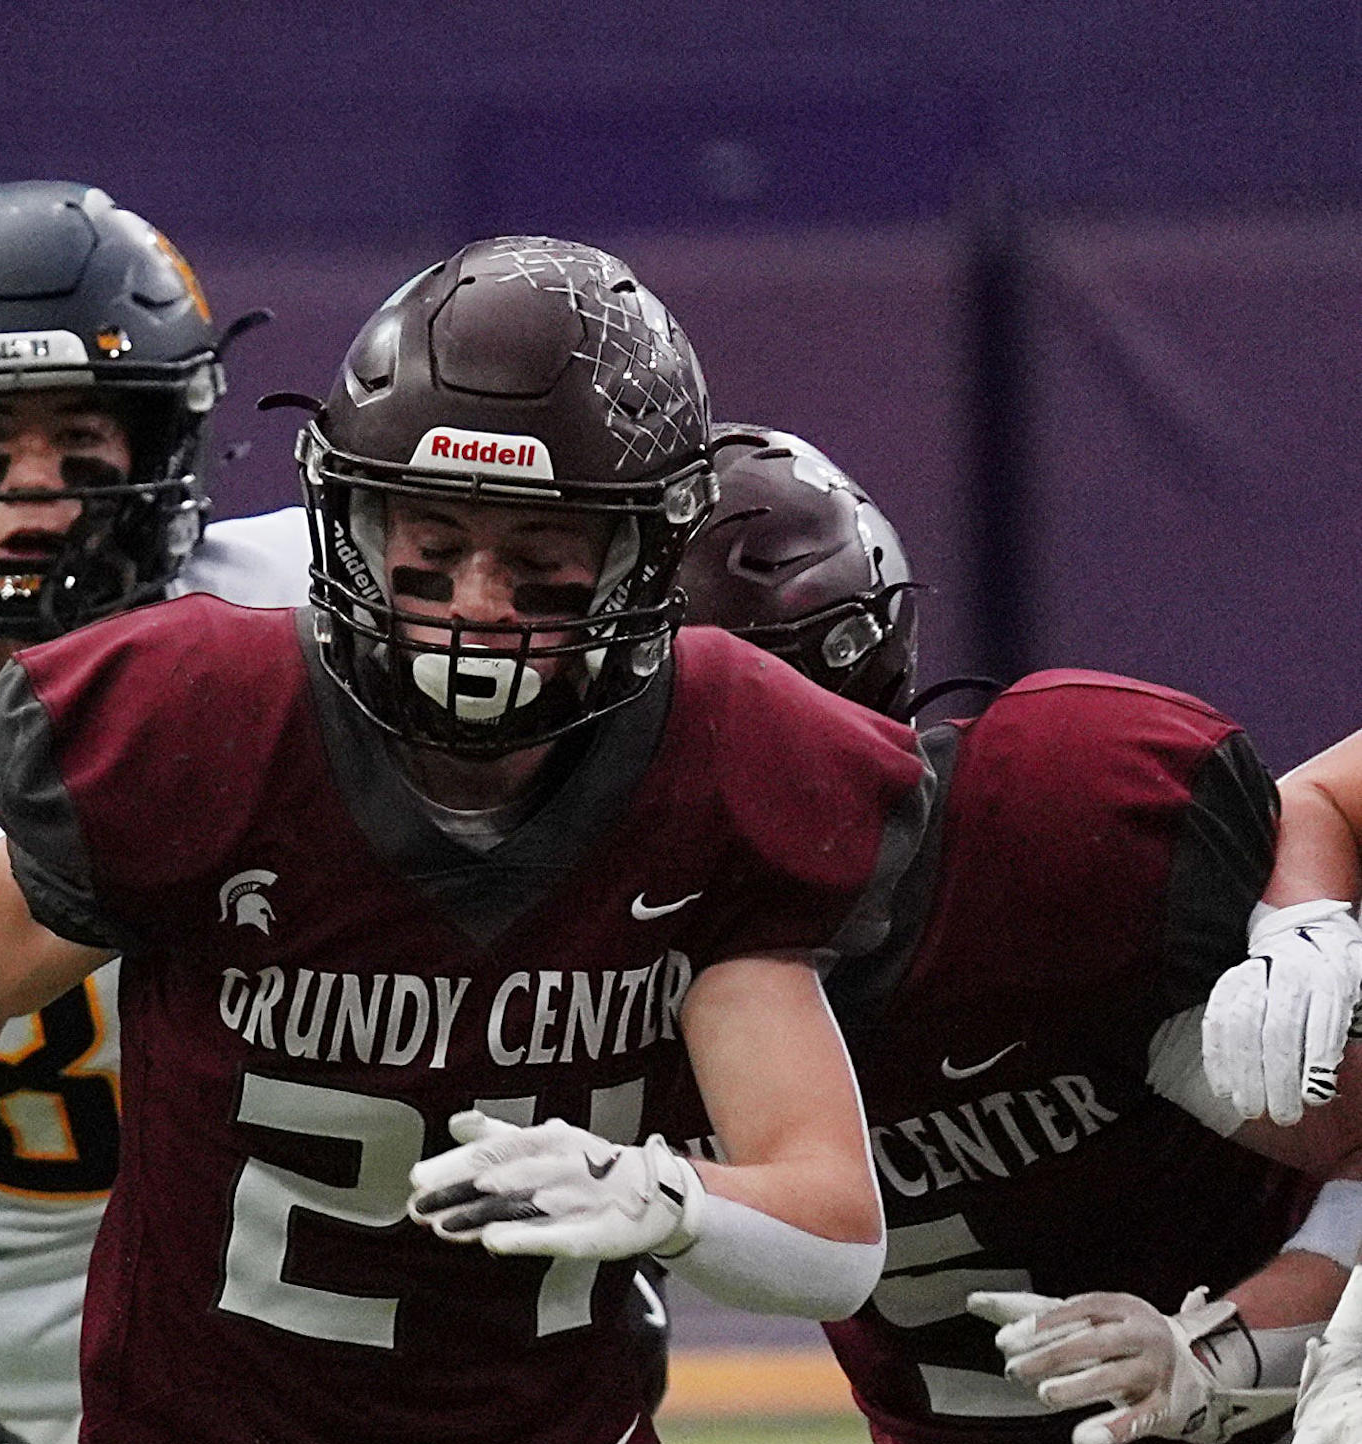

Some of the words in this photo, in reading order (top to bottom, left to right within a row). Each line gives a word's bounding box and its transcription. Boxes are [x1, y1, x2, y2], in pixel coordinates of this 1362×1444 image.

[430, 434, 536, 467] Riddell
[219, 965, 473, 1069] GRUNDY
[486, 947, 693, 1067] CENTER
[872, 1073, 1120, 1198] CENTER
